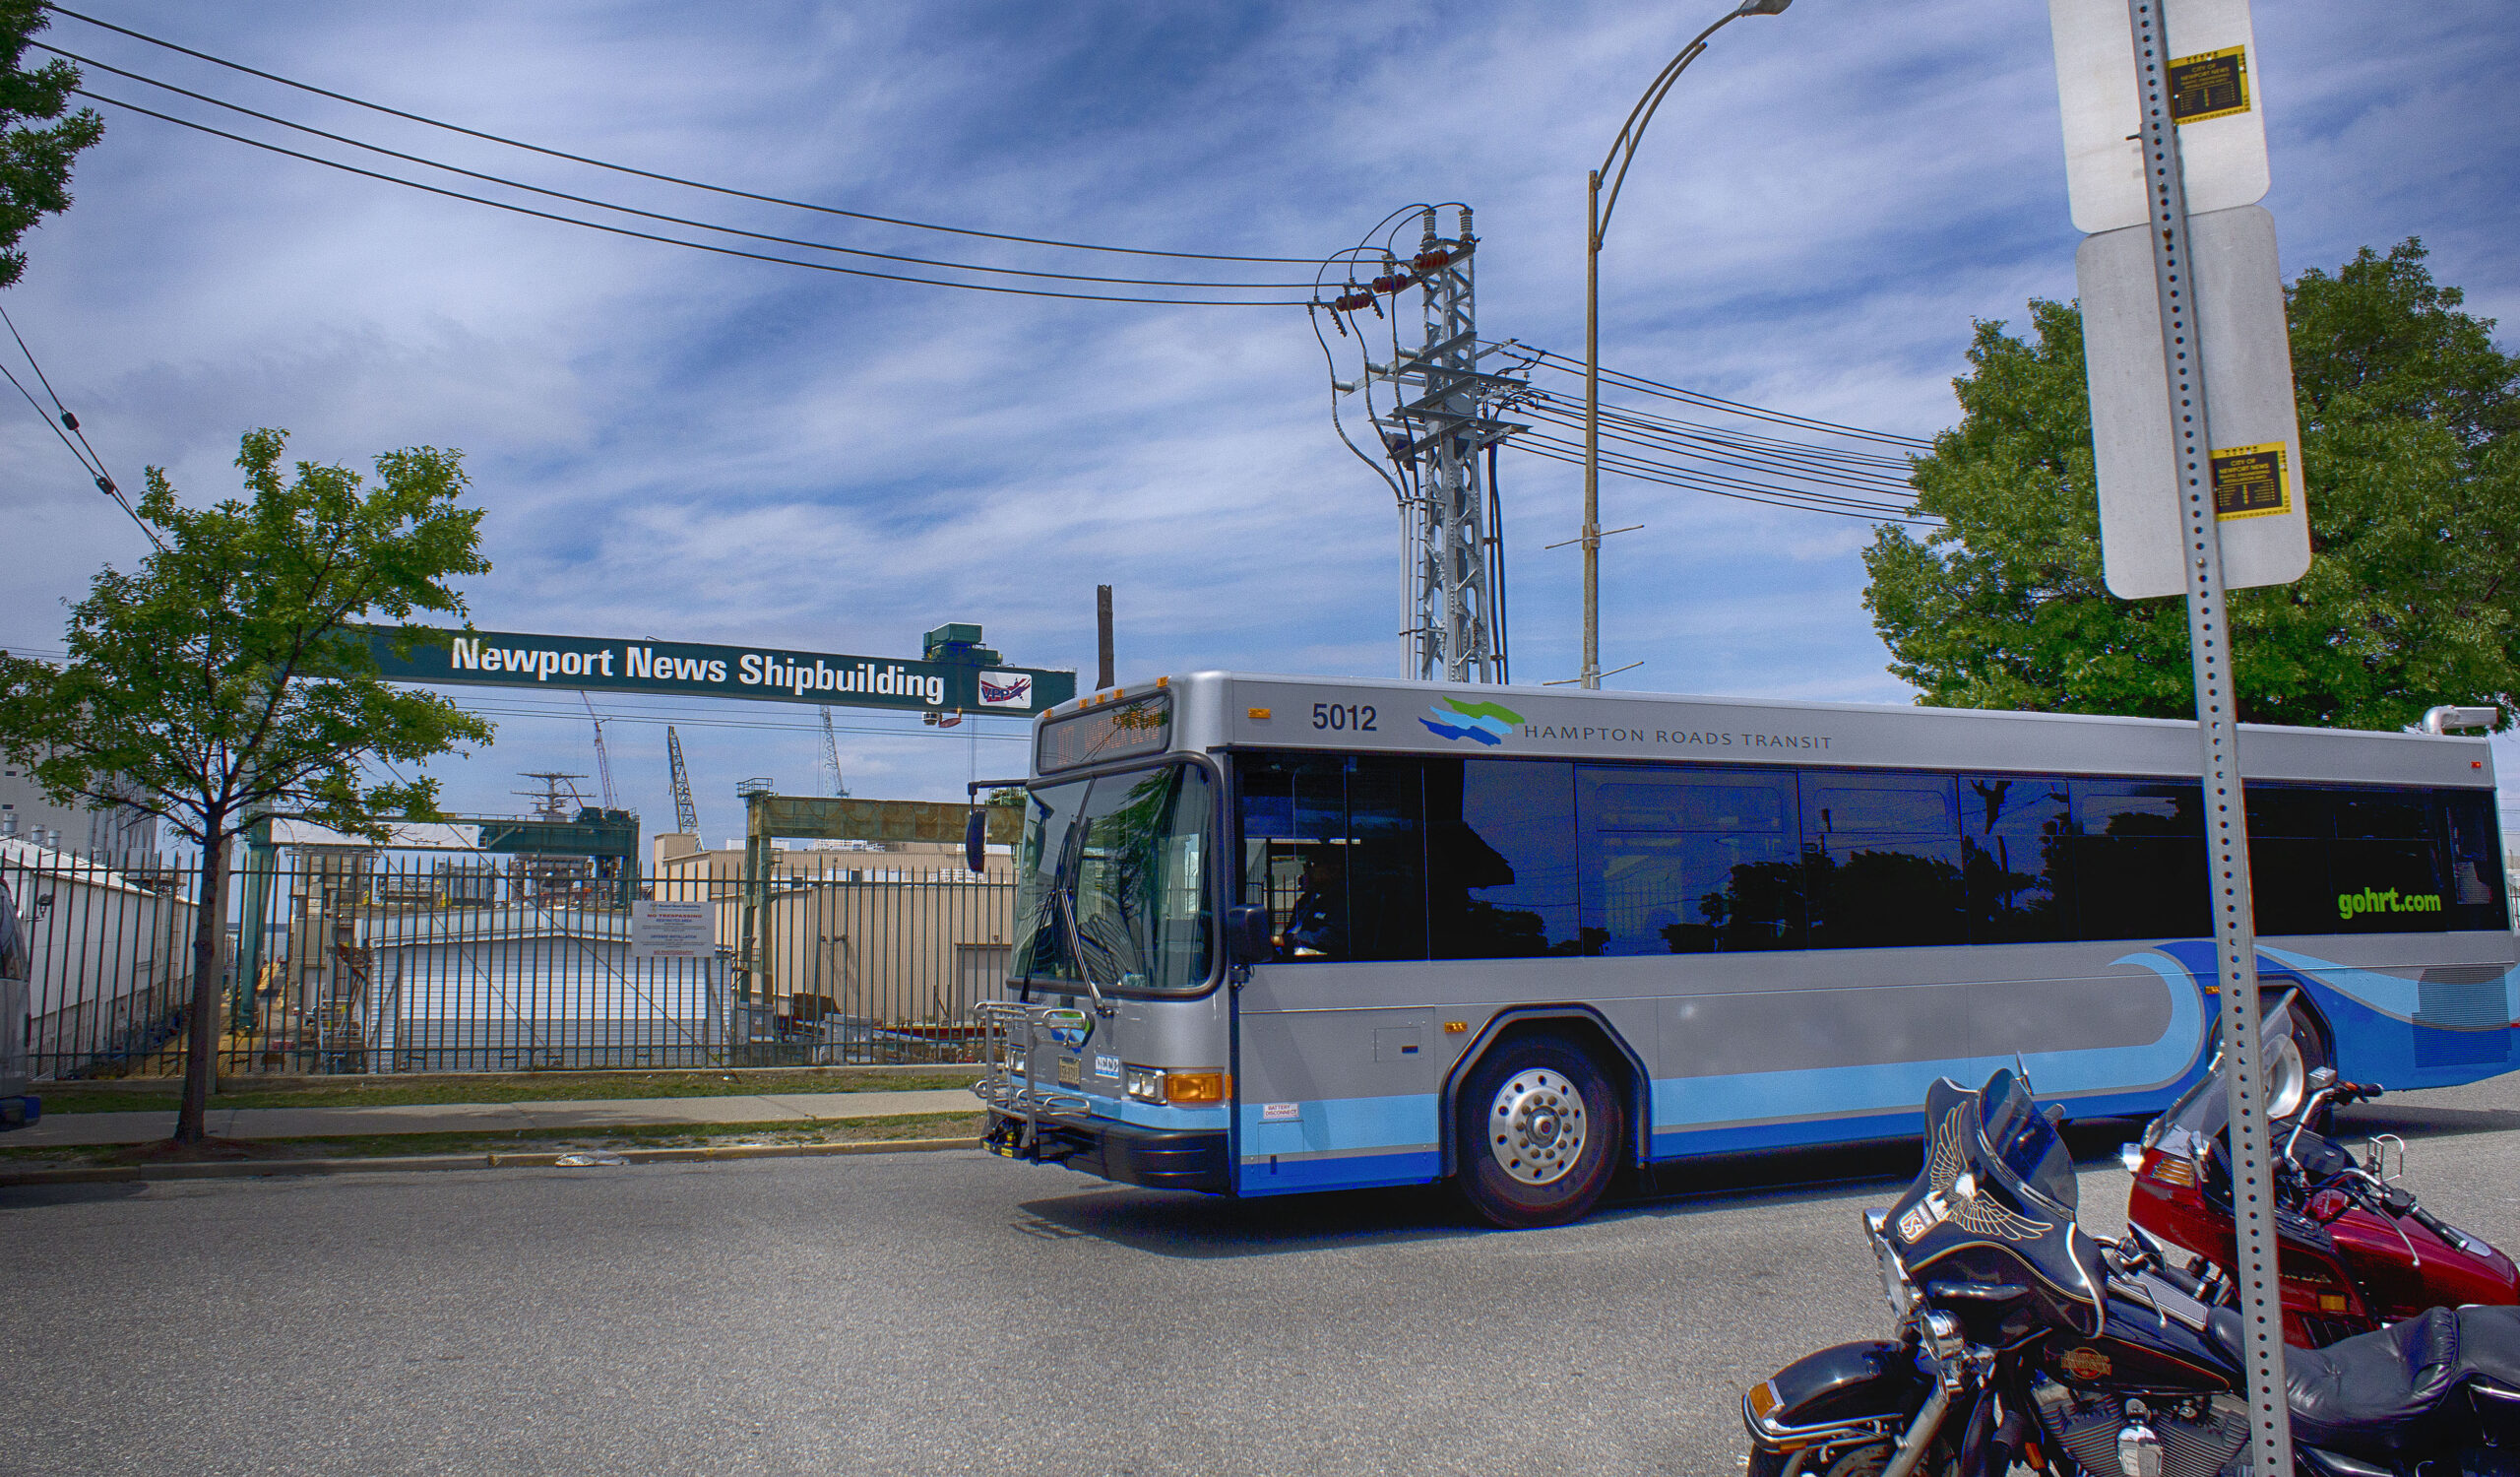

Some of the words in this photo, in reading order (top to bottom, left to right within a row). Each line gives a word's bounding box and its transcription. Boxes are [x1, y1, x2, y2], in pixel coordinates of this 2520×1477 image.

[452, 637, 614, 681] Newport
[626, 646, 727, 682] News
[738, 654, 945, 705] Shipbuilding
[981, 687, 1010, 700] VPP
[1312, 702, 1377, 732] 5012
[1524, 725, 1644, 742] HAMPTON
[1656, 730, 1732, 745] ROADS
[1741, 734, 1833, 749] TRANSIT
[2338, 886, 2442, 920] gohrt.com
[1898, 1208, 1927, 1241] USA
